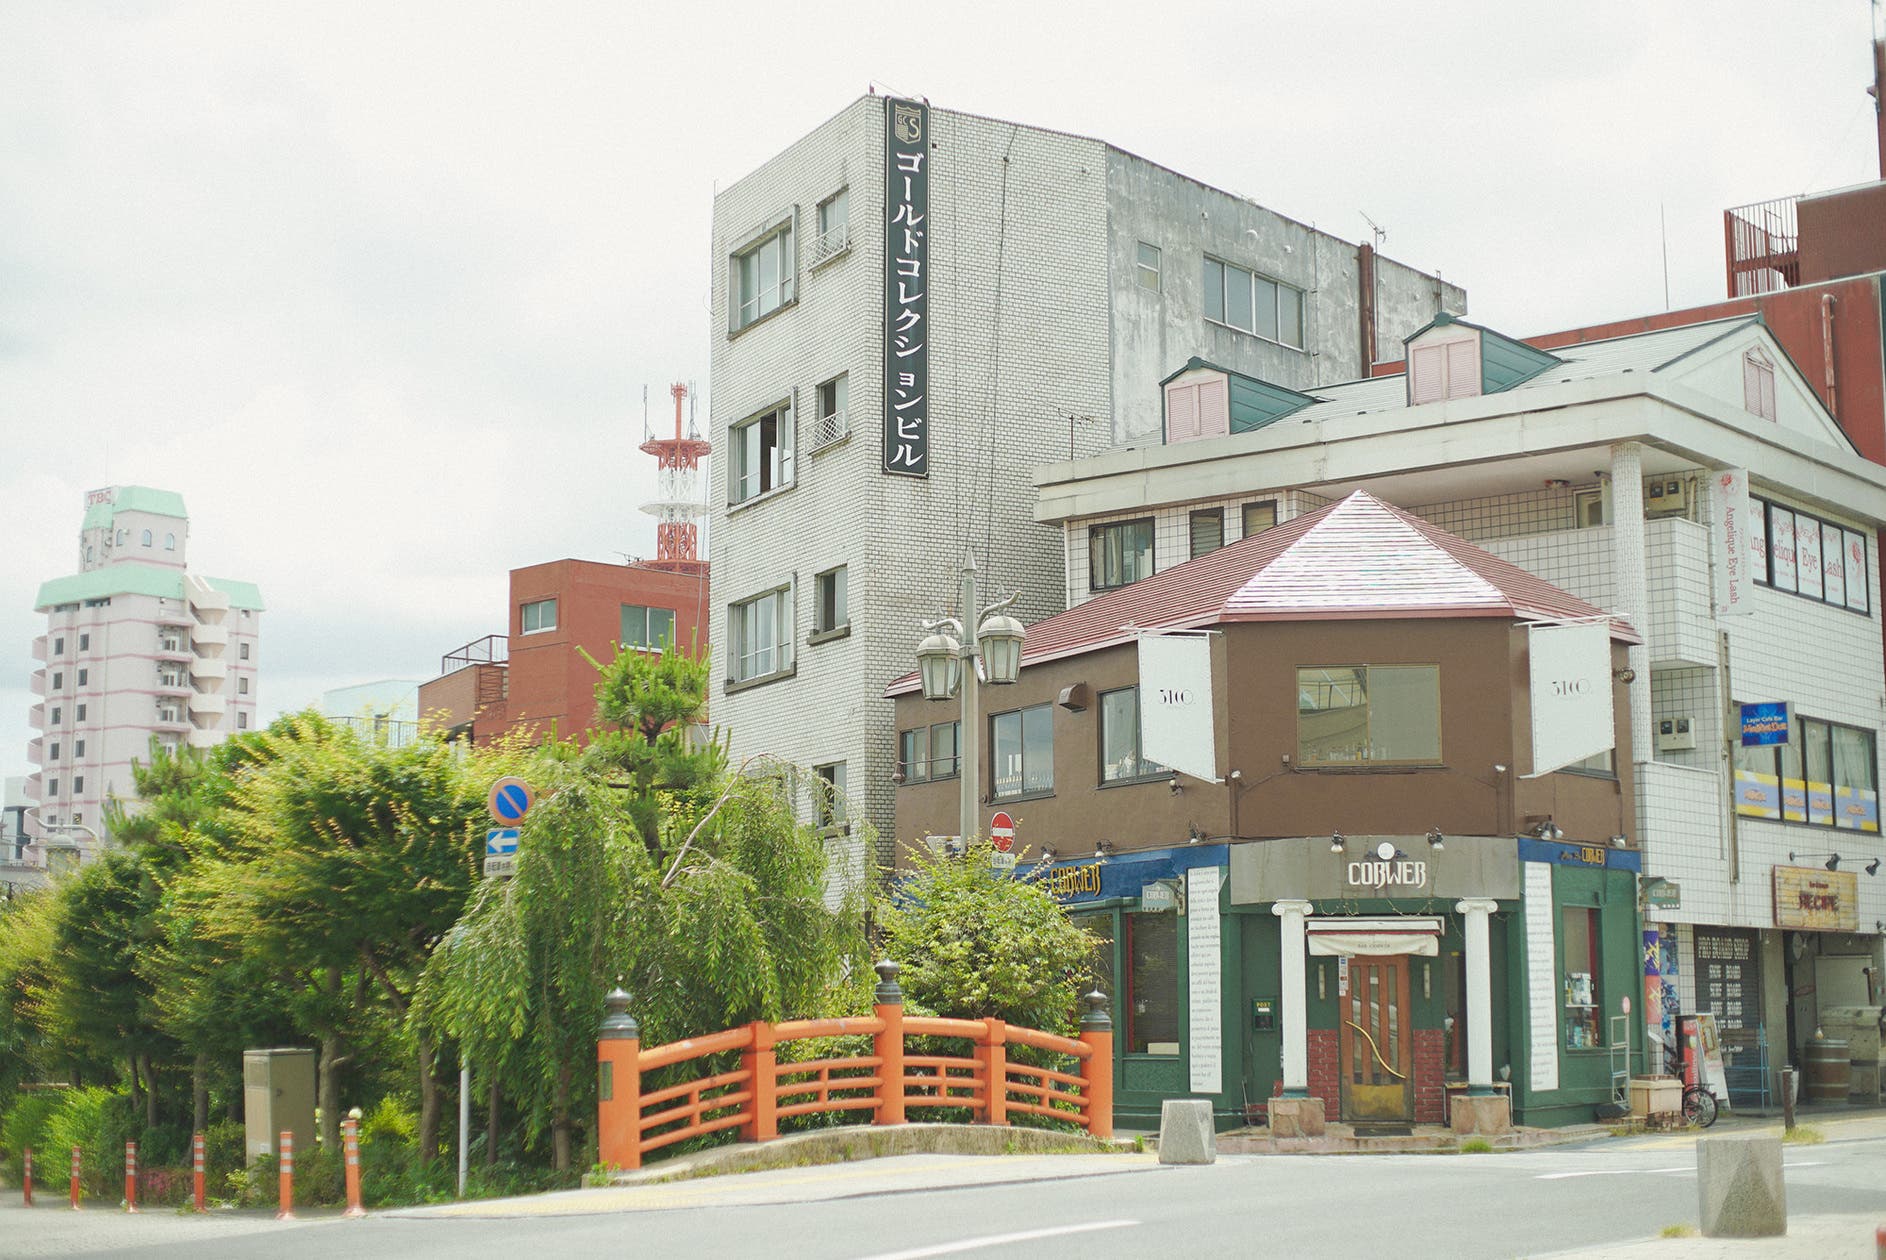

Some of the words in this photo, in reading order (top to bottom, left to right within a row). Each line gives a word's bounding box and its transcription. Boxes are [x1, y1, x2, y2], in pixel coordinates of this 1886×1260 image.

[890, 152, 925, 467] ゴールドコレクションビル
[1724, 506, 1737, 555] Angelique
[1726, 557, 1738, 576] Eye
[1802, 546, 1818, 573] Eye
[1825, 558, 1843, 579] ash
[1729, 579, 1740, 604] Lash
[1348, 861, 1426, 889] COBWEB
